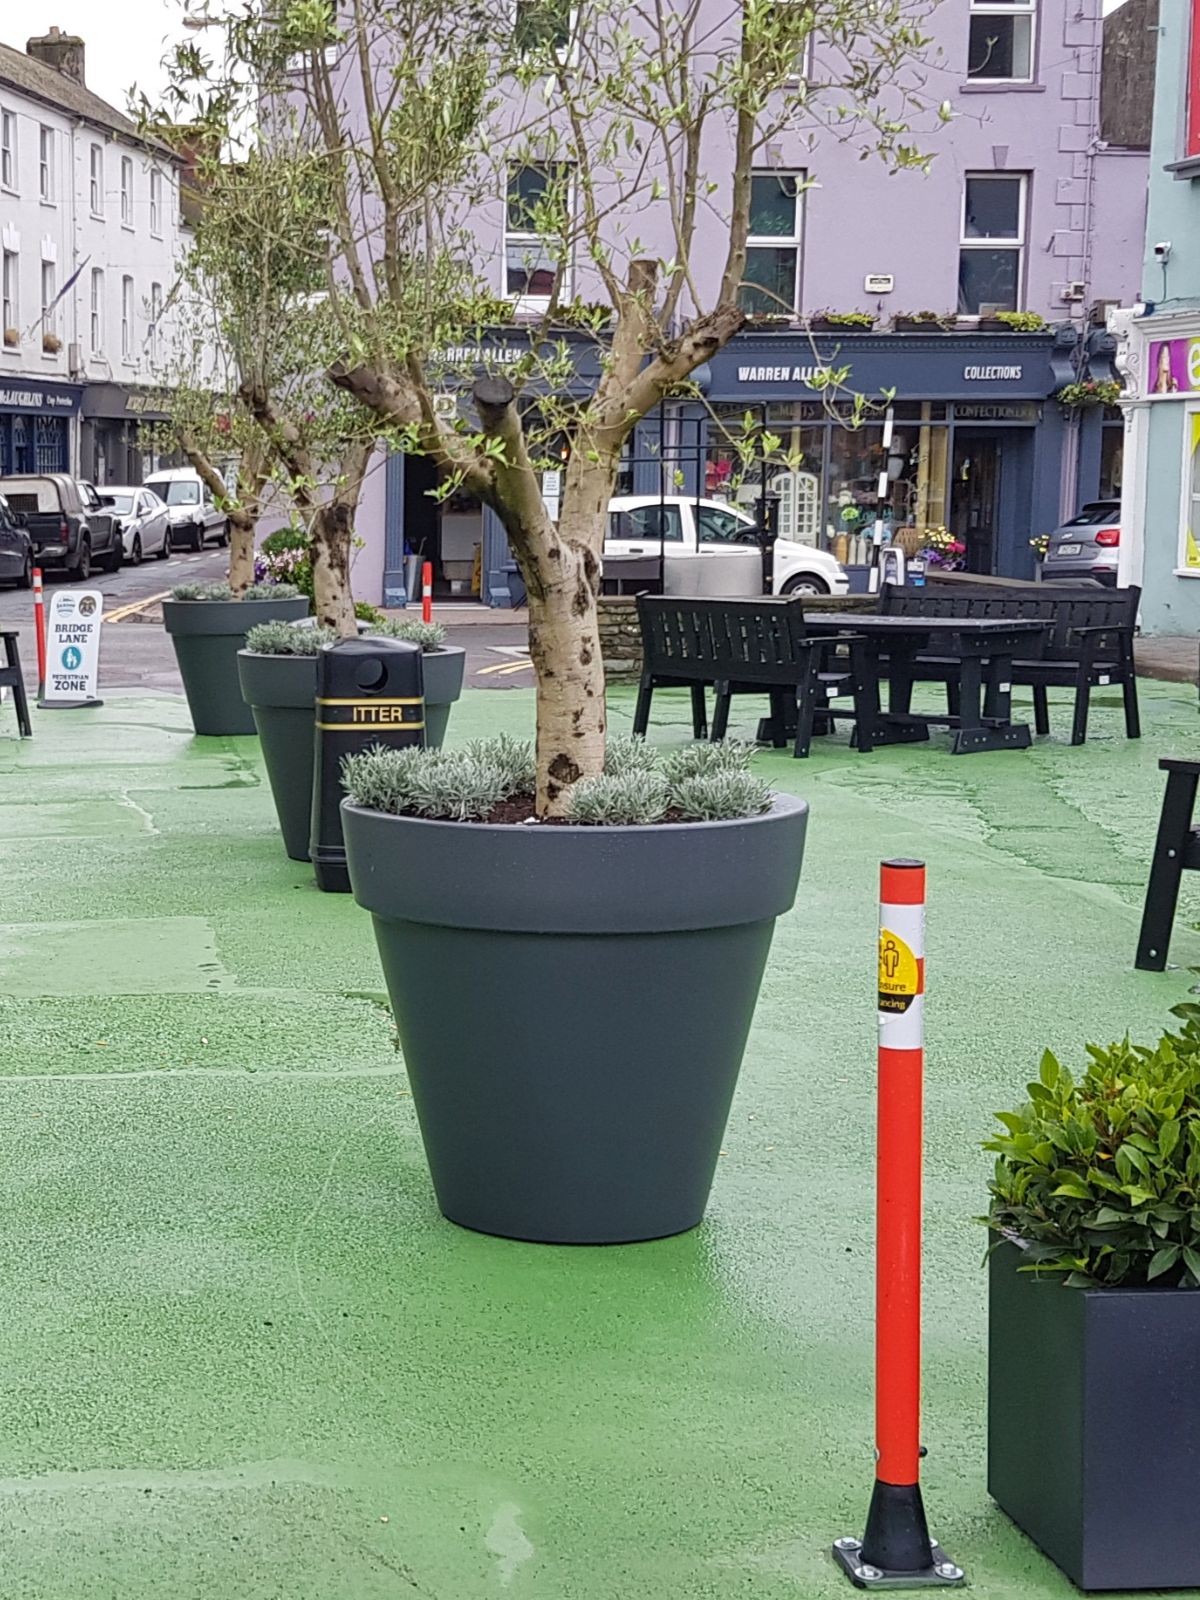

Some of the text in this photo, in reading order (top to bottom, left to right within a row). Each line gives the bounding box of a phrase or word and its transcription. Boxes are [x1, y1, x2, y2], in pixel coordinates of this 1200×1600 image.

[738, 366, 829, 381] WARREN ALLE
[964, 366, 1022, 380] COLLECTIONS
[55, 623, 93, 633] BRIDGE
[58, 634, 88, 643] LANE
[54, 681, 86, 691] ZONE
